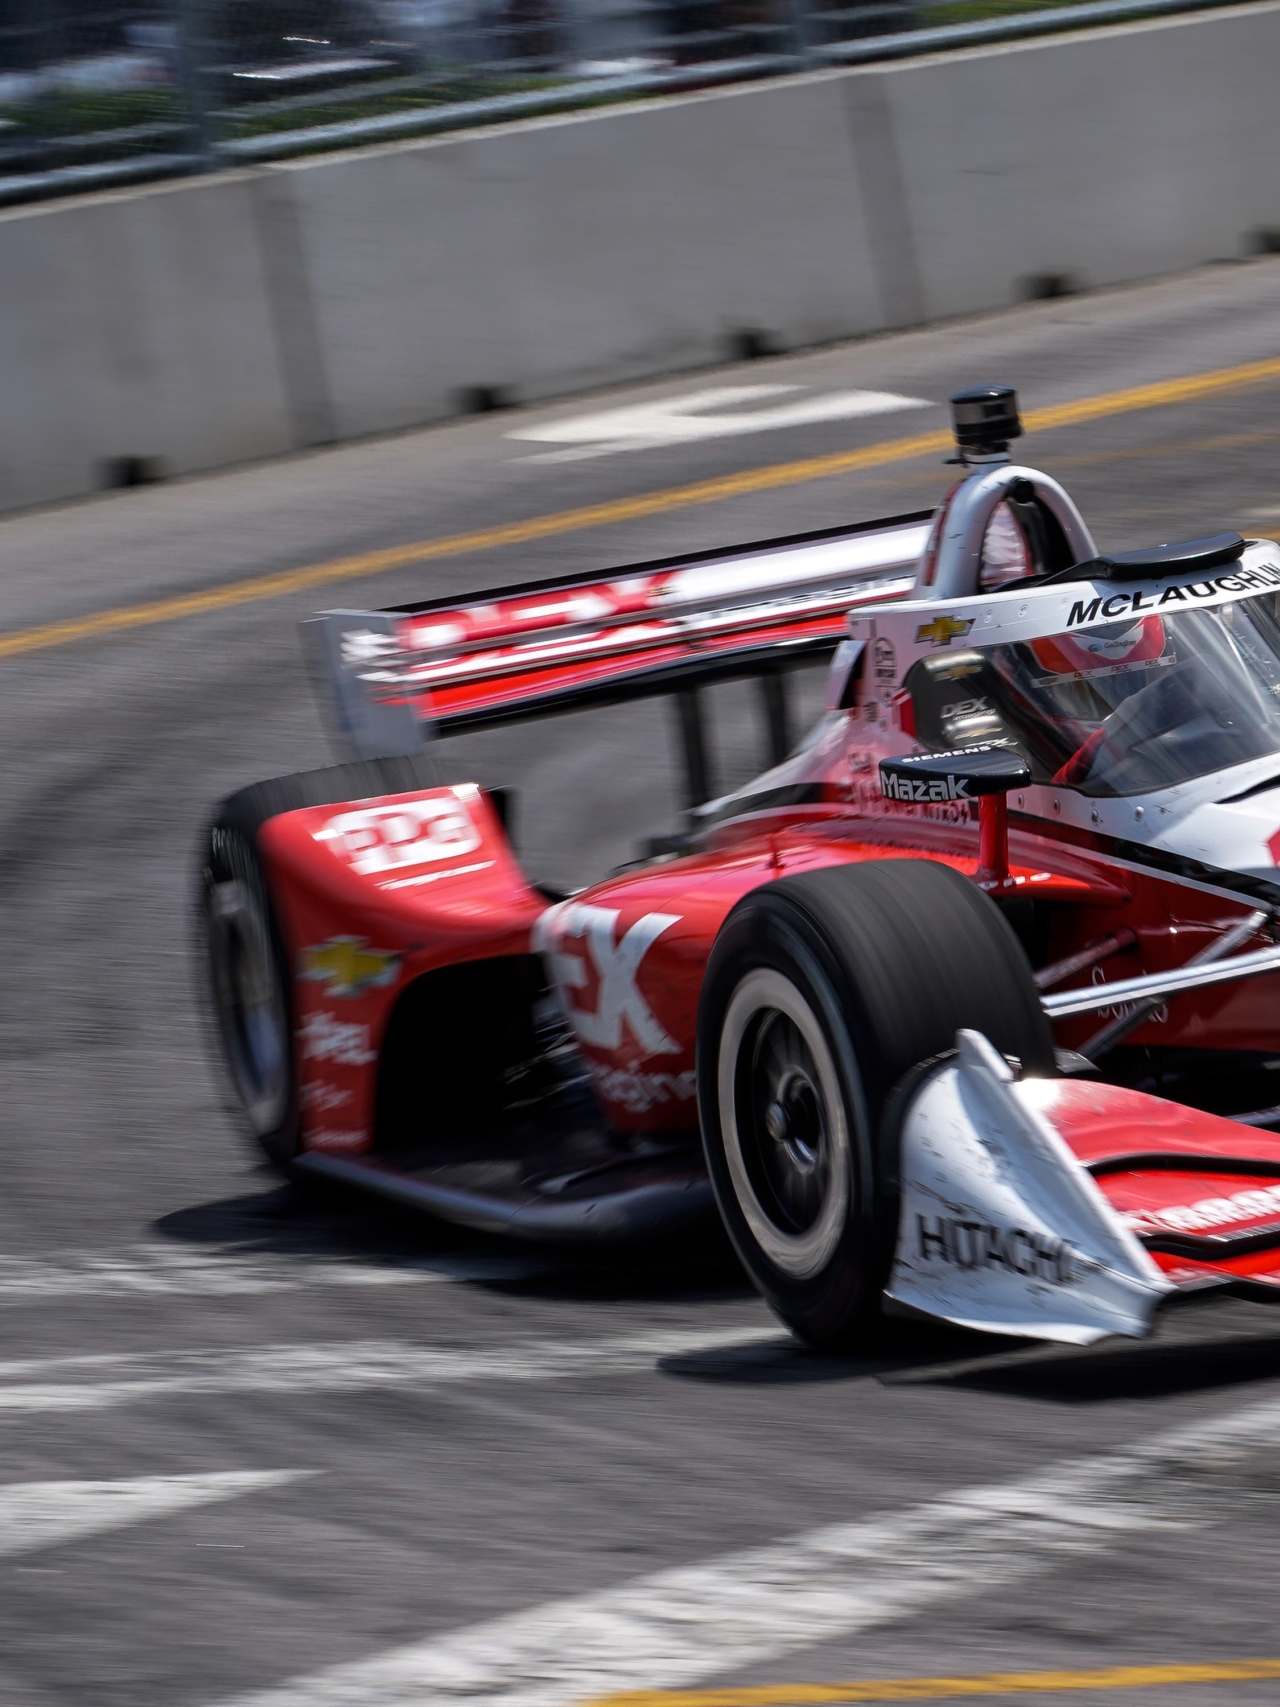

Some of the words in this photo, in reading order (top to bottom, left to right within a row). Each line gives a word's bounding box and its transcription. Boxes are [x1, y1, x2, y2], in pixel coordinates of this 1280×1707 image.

[1111, 664, 1130, 673] DEX
[940, 695, 989, 719] DEX
[901, 745, 992, 764] SIEMENS
[880, 770, 972, 802] Mazak
